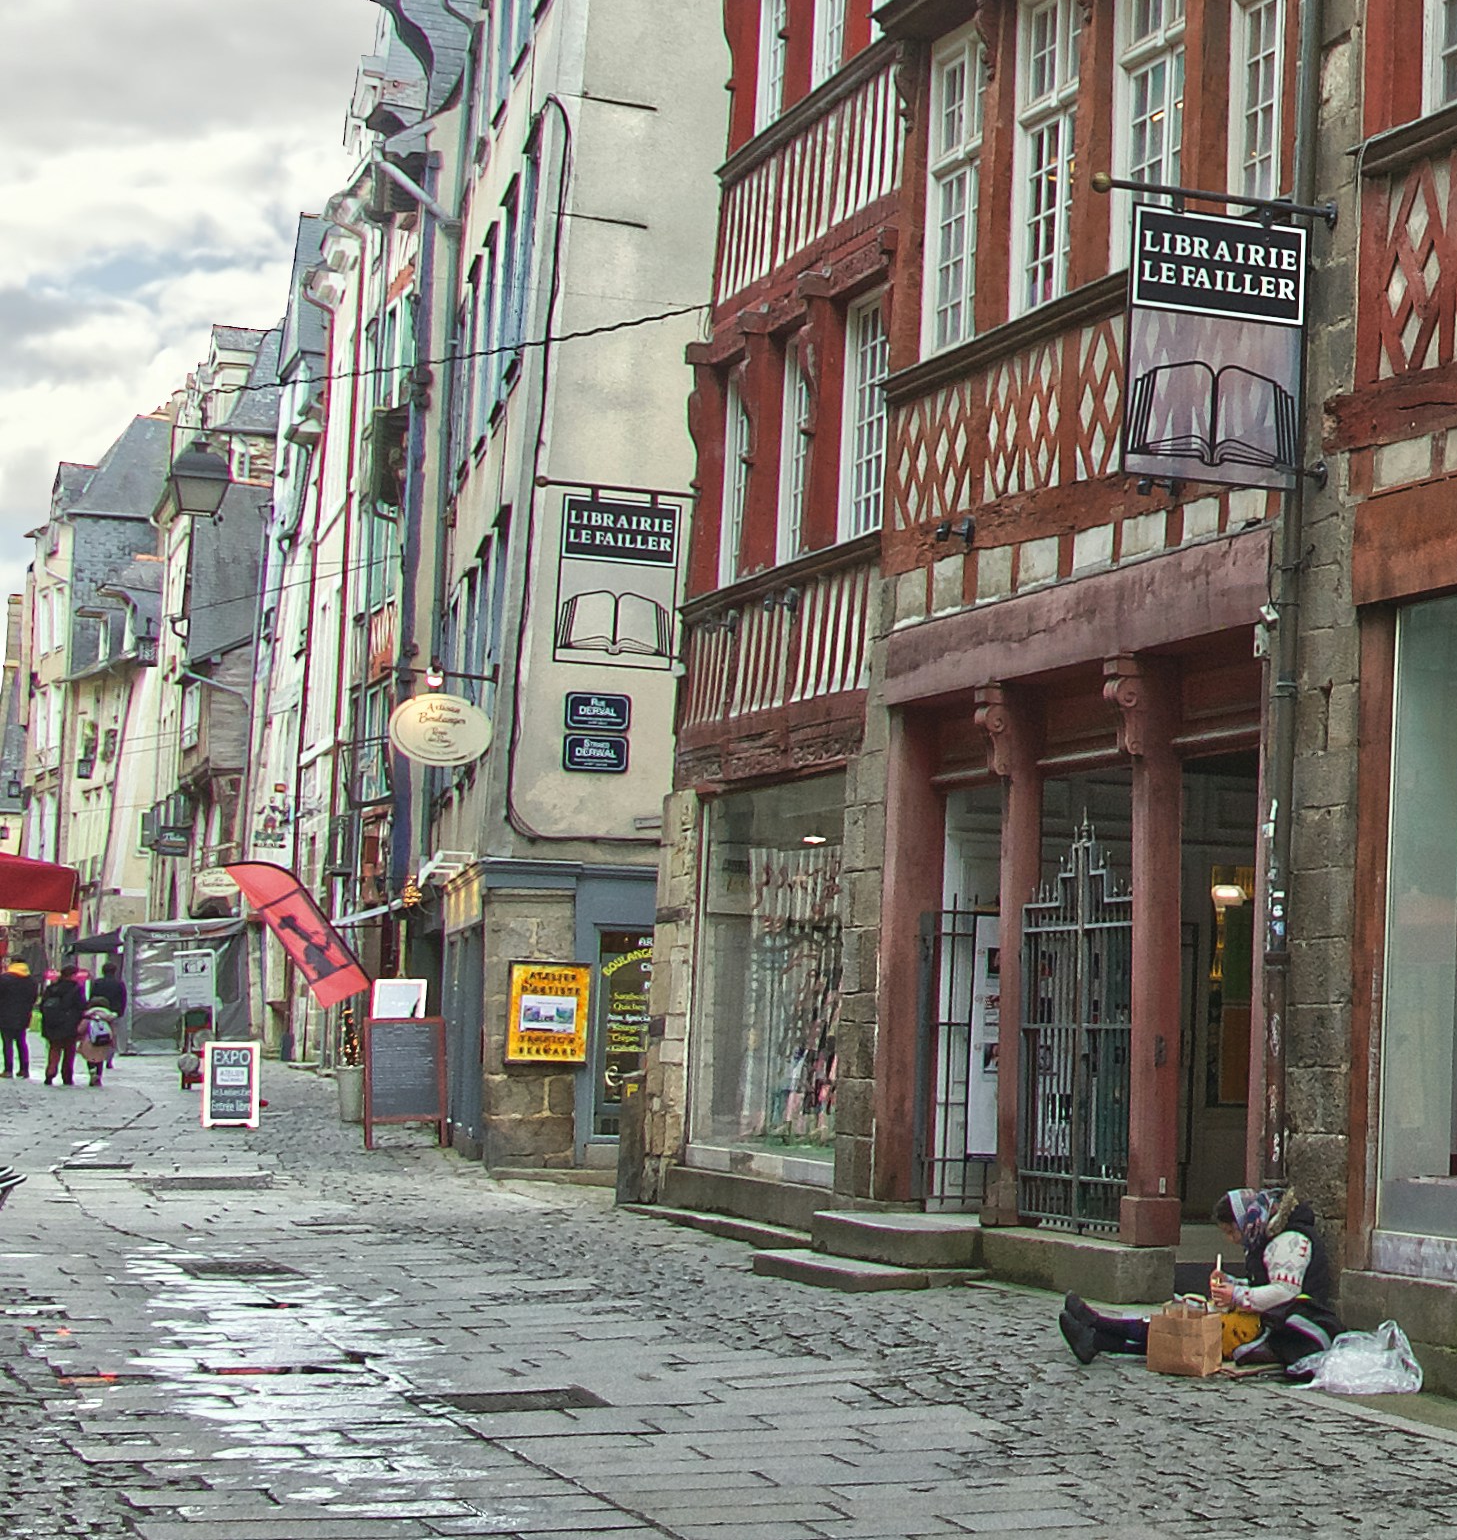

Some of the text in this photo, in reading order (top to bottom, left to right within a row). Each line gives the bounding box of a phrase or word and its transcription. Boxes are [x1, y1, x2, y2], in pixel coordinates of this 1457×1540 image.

[1143, 229, 1297, 271] LIBRAIRIE
[1142, 260, 1296, 301] LE FAILLER
[570, 509, 673, 533] LIBRAIRIE
[568, 528, 672, 552] LE FAILLER
[529, 971, 577, 982] ATELIER
[521, 983, 581, 996] D'ARTISTE
[213, 1049, 251, 1066] EXPO
